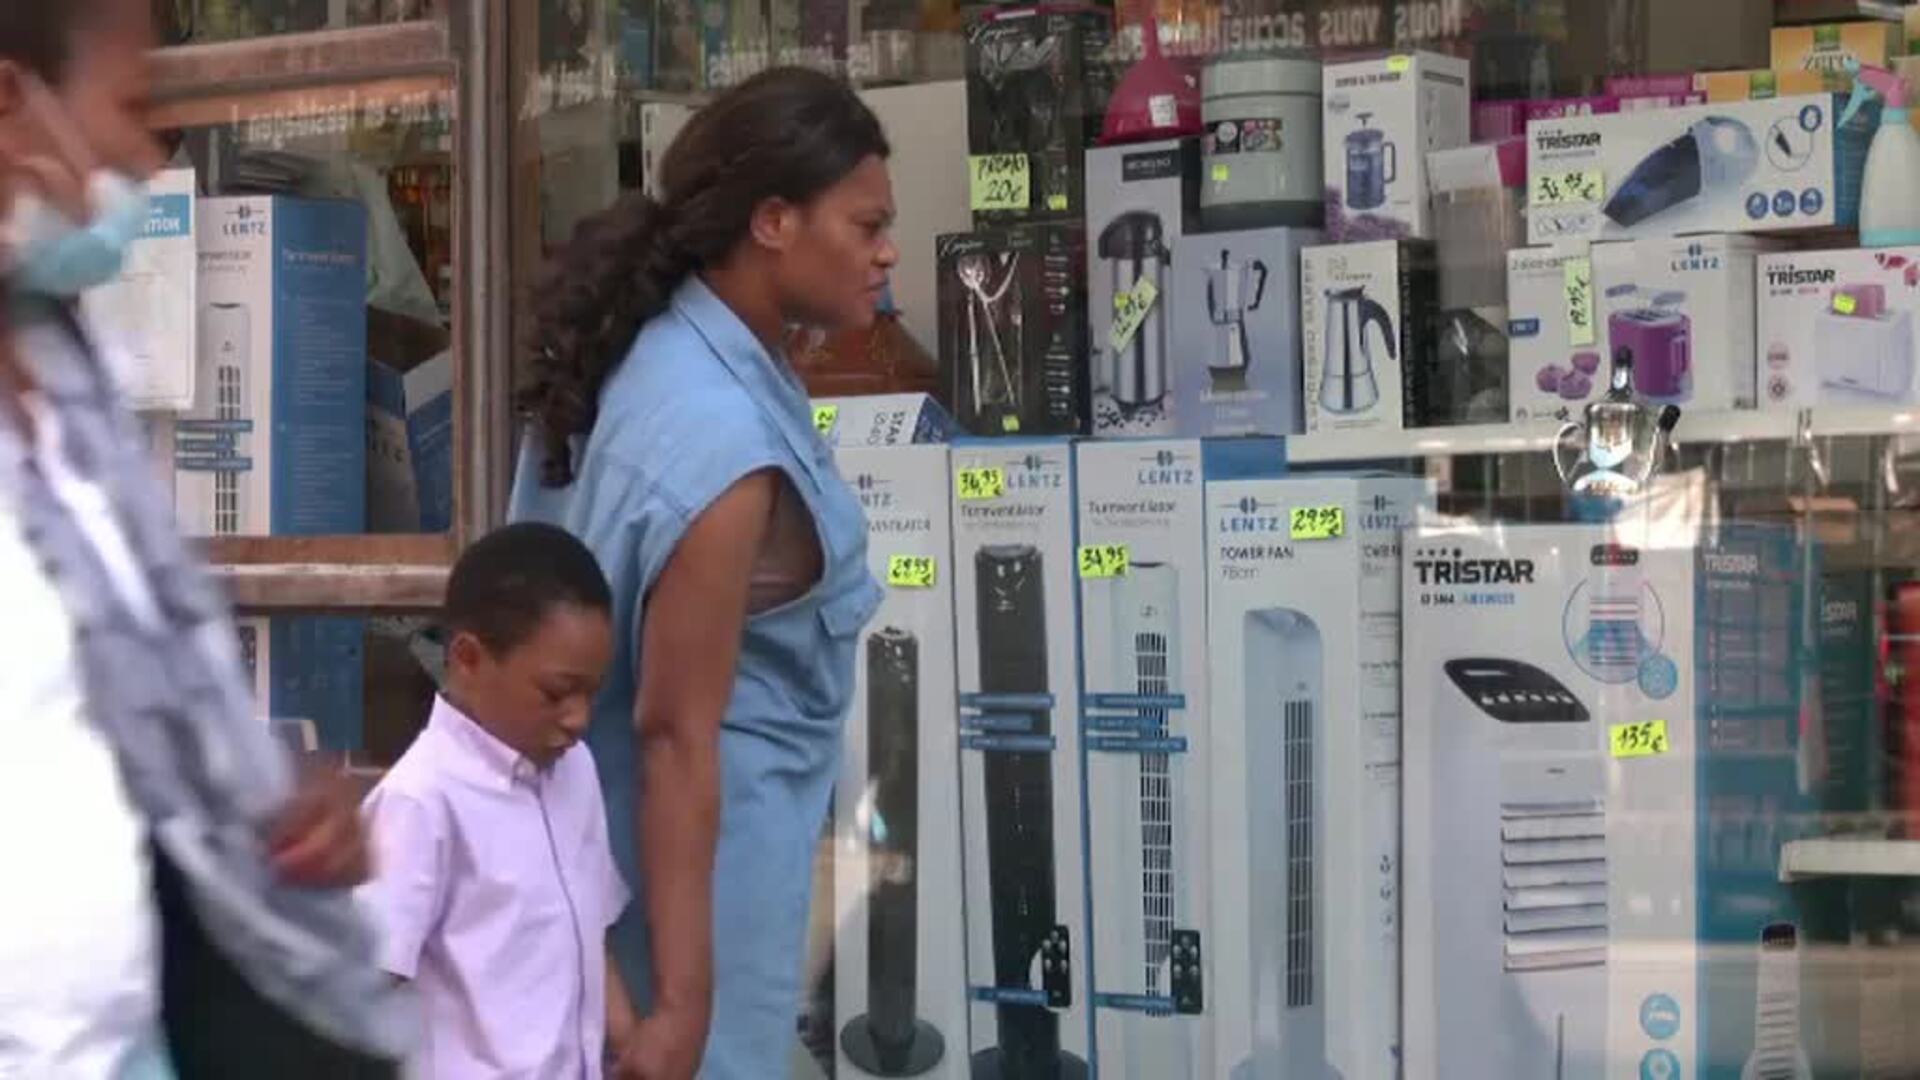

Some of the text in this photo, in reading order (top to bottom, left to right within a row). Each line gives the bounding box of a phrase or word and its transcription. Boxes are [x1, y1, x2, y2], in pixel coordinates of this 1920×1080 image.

[1536, 133, 1602, 152] TRISTAR
[220, 223, 267, 237] LENTZ
[1671, 257, 1720, 272] LENTZ
[1767, 269, 1836, 288] TRISTAR
[1007, 472, 1061, 489] LENTZ
[1138, 469, 1194, 485] LENTZ
[860, 493, 893, 508] NTZ
[1220, 517, 1280, 532] LENTZ
[1221, 546, 1296, 560] TOWER FAN
[1413, 556, 1535, 585] TRISTAR
